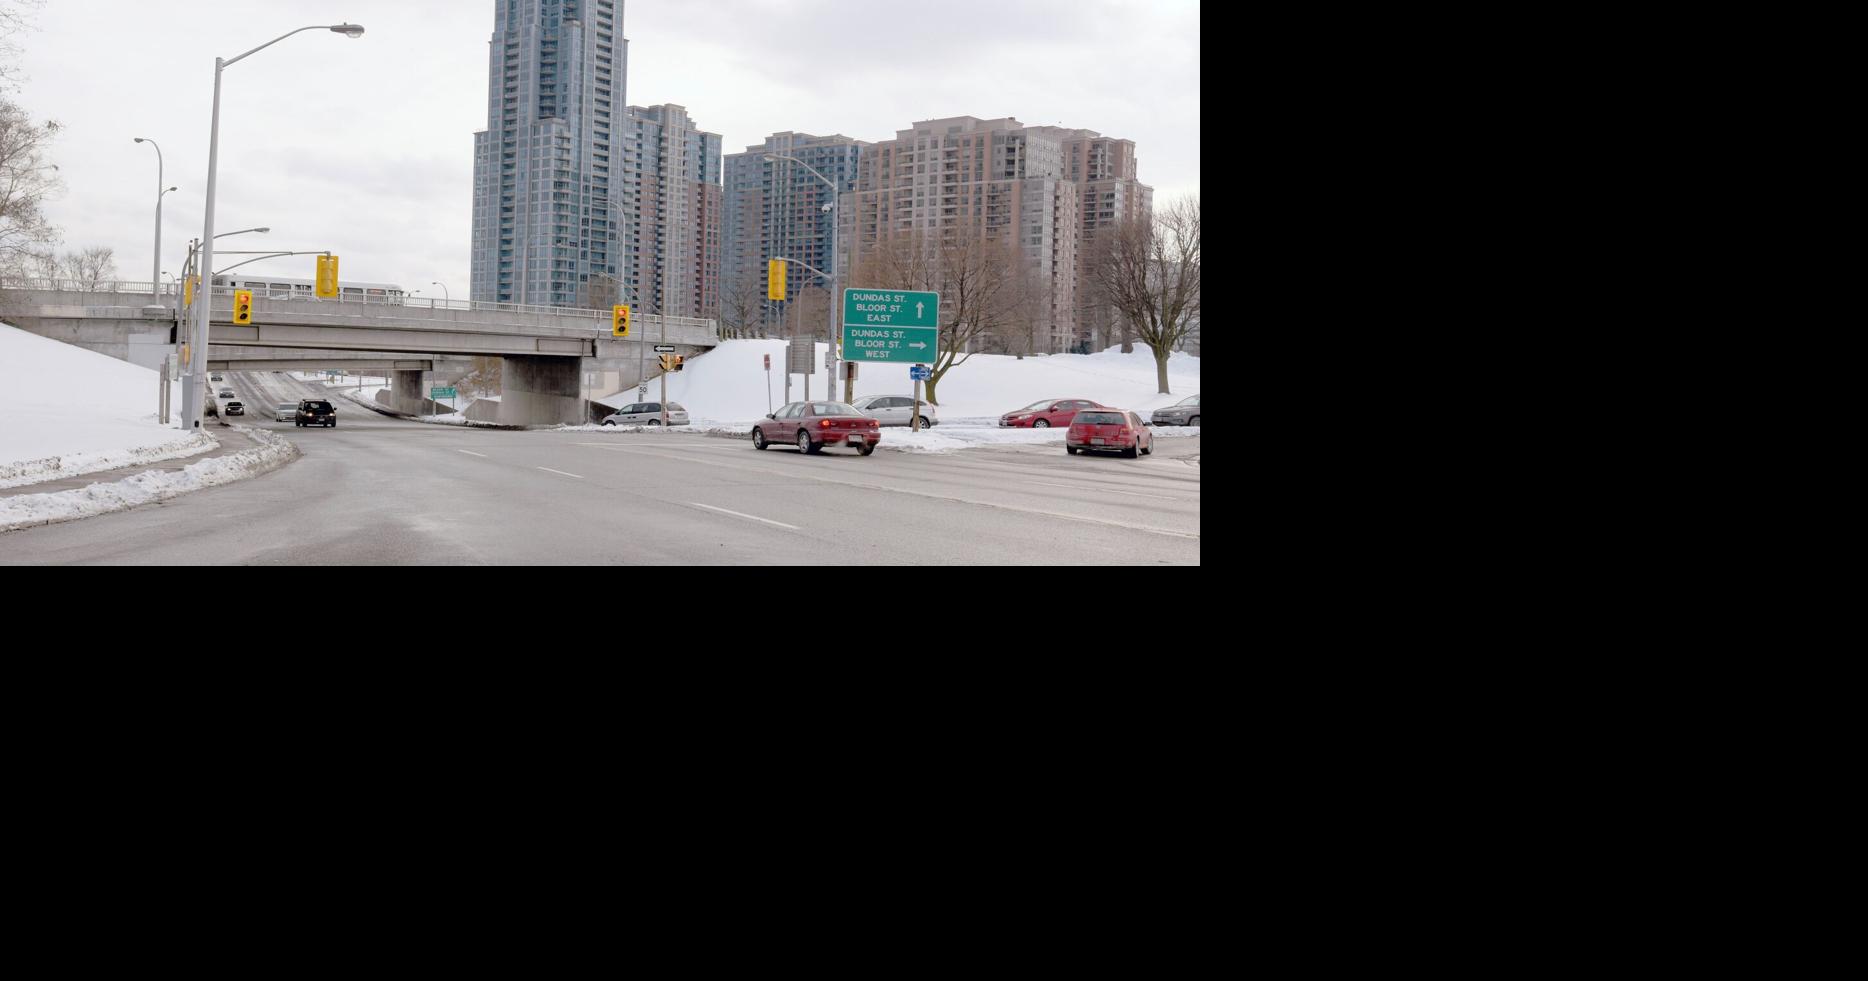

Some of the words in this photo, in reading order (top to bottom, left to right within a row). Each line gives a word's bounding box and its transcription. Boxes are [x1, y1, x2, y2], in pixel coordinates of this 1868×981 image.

[853, 293, 891, 302] DUNDAS
[894, 295, 907, 303] ST.
[856, 304, 887, 312] BLOOR
[889, 305, 903, 313] ST.
[867, 314, 892, 322] EAST
[851, 330, 889, 338] DUNDAS
[855, 340, 885, 348] BLOOR
[888, 341, 902, 349] ST.
[865, 350, 890, 358] WEST
